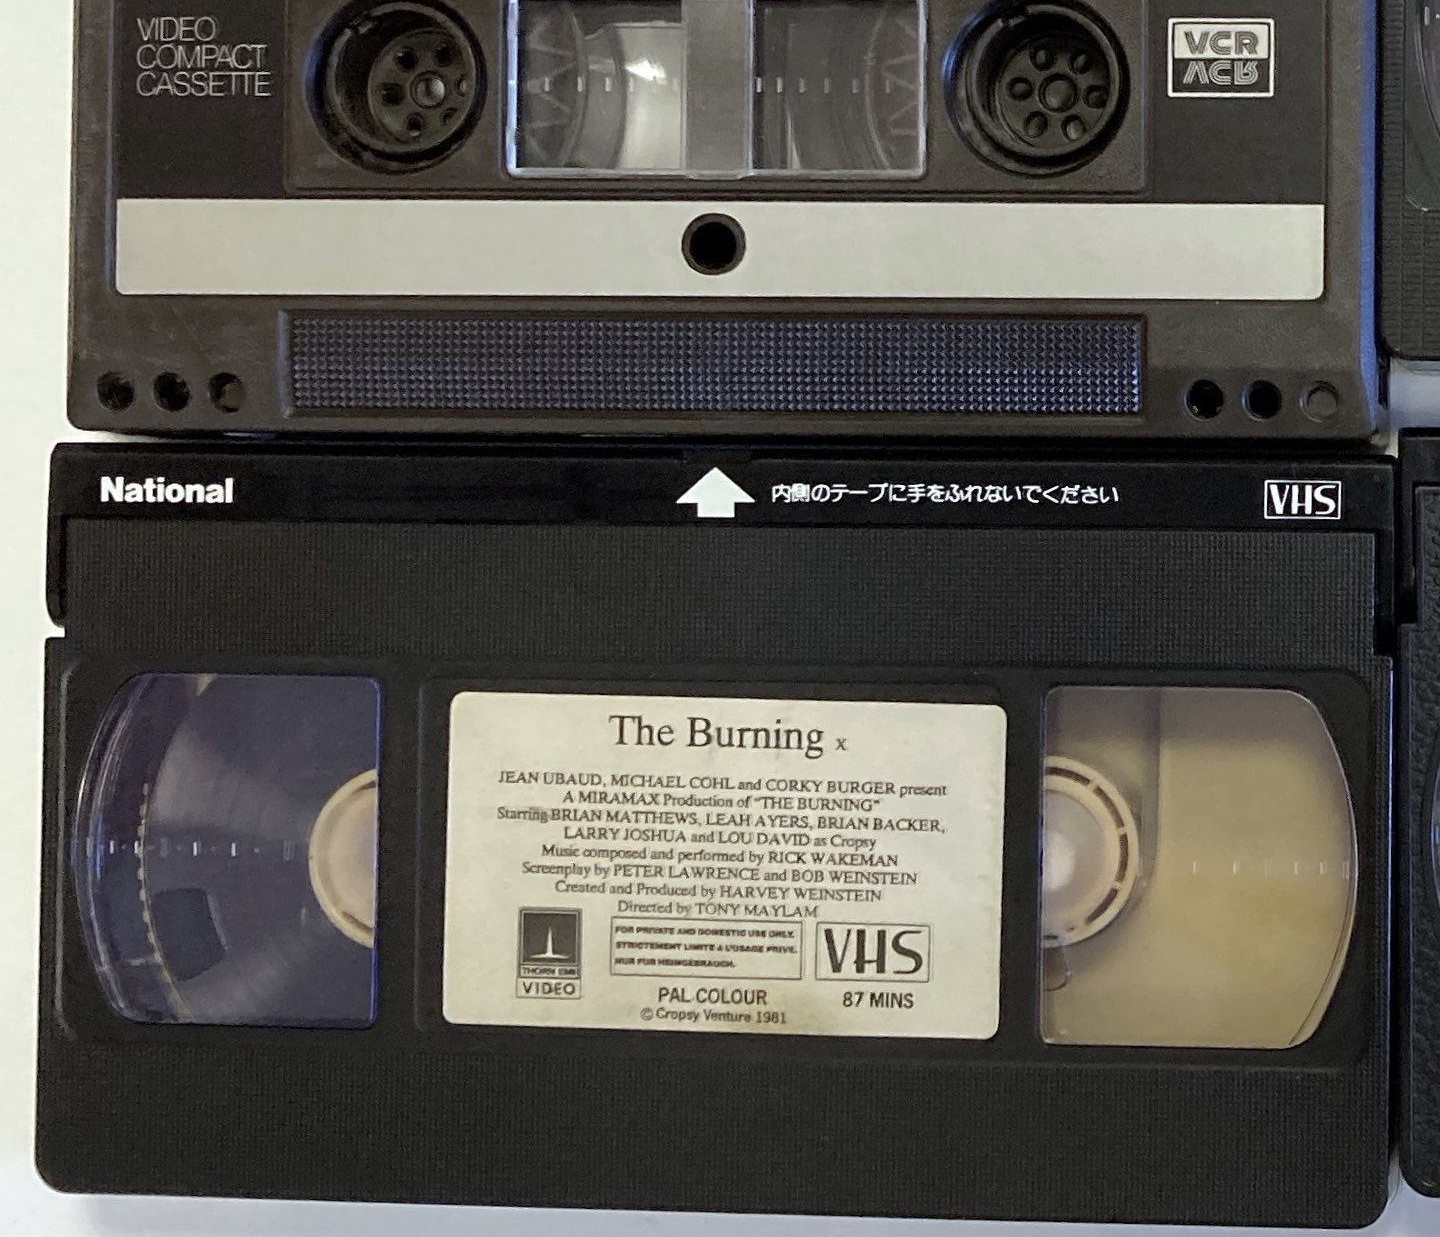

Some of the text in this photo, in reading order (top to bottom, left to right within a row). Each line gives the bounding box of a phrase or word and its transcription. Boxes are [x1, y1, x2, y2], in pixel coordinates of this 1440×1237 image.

[137, 16, 216, 41] VIDEO
[1183, 31, 1260, 55] VCR
[137, 43, 267, 69] COMPACT
[137, 71, 271, 96] CASSETTE
[101, 476, 233, 503] National
[772, 483, 1118, 504] 内側のテープに手をふれないでください
[1268, 483, 1339, 516] VHS
[609, 715, 675, 746] The
[686, 717, 824, 759] Burning
[498, 771, 539, 783] JEAN
[611, 774, 686, 788] MICHAEL
[689, 777, 735, 789] COHL
[738, 779, 762, 790] and
[766, 779, 823, 792] CORKY
[827, 781, 896, 794] BURGER
[900, 786, 946, 797] present
[563, 791, 574, 803] A
[579, 791, 660, 805] MIRAMAX
[663, 793, 733, 807] Production
[737, 796, 752, 808] of
[550, 810, 602, 824] BRIAN
[606, 810, 702, 826] MATTHEWS,
[705, 813, 751, 826] LEAH
[755, 815, 813, 830] AYERS,
[818, 816, 869, 830] BRIAN
[873, 818, 945, 834] BACKER,
[564, 826, 876, 851] LARRY JOSHUA and LOU DAVID as Cropsy
[542, 844, 898, 867] Music composed and performed by RICK WAKEMAN
[522, 861, 917, 885] Screenplay by PETER LAWRENCE and BOB WEINSTEIN
[555, 880, 882, 902] Created and Produced by HARVEY WEINSTEIN
[618, 900, 819, 918] Directed by TONY MAYLAM
[824, 928, 923, 975] VHS
[523, 982, 575, 995] VIDEO
[658, 987, 767, 1006] PAL COLOUR
[843, 991, 913, 1009] 87 MINS
[656, 1007, 787, 1025] Cropsy Venture 1981
